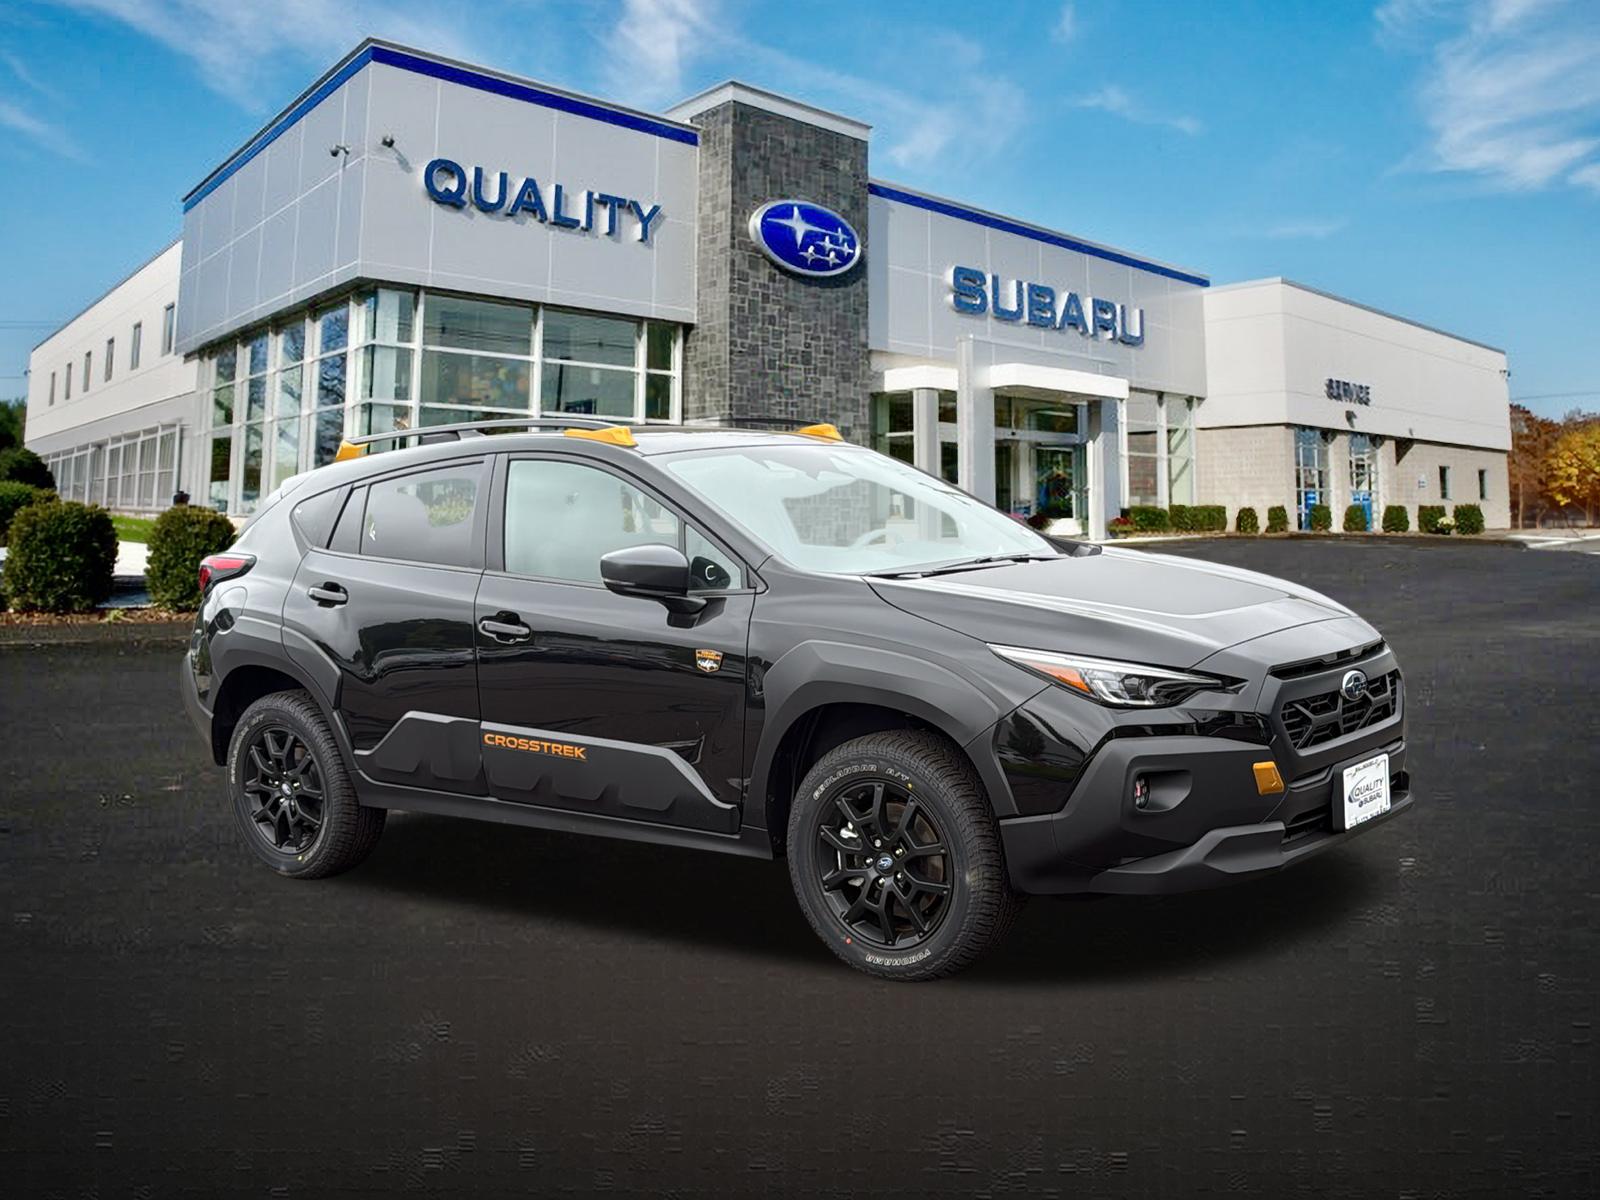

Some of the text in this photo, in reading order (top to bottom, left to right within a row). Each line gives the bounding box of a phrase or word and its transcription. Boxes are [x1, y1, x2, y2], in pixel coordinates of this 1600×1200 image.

[424, 158, 662, 243] QUALITY
[951, 265, 1145, 347] SUBARU
[1325, 378, 1370, 406] SERVICE
[484, 733, 586, 760] CROSSTREK
[1354, 777, 1384, 797] QUALITY
[1363, 791, 1383, 804] SUBARU
